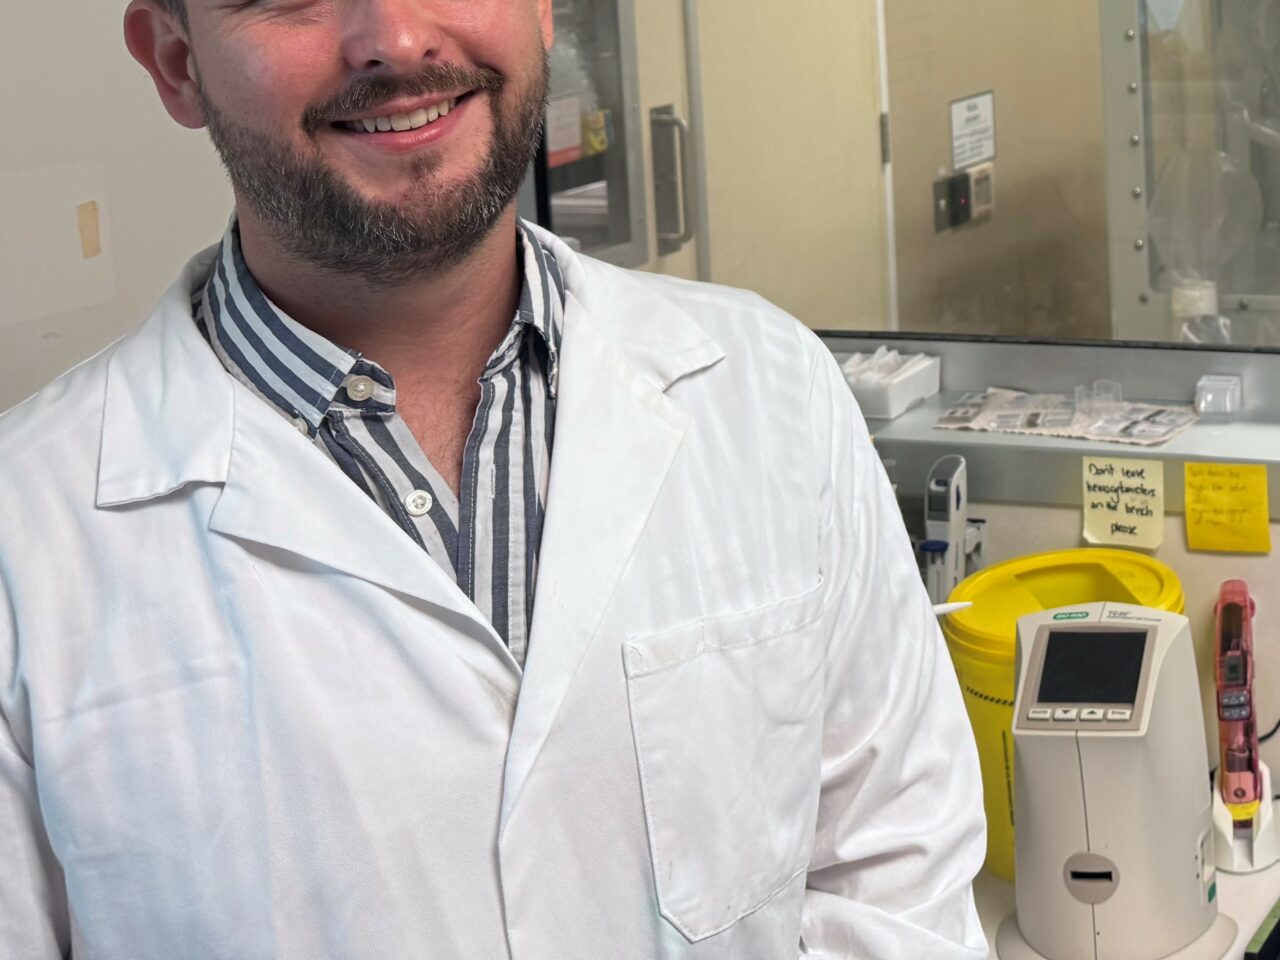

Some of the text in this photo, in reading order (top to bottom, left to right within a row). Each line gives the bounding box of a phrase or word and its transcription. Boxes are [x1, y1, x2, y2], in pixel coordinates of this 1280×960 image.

[1121, 466, 1146, 480] leave
[1090, 500, 1105, 510] on
[1124, 502, 1154, 518] bench
[1109, 522, 1138, 536] please
